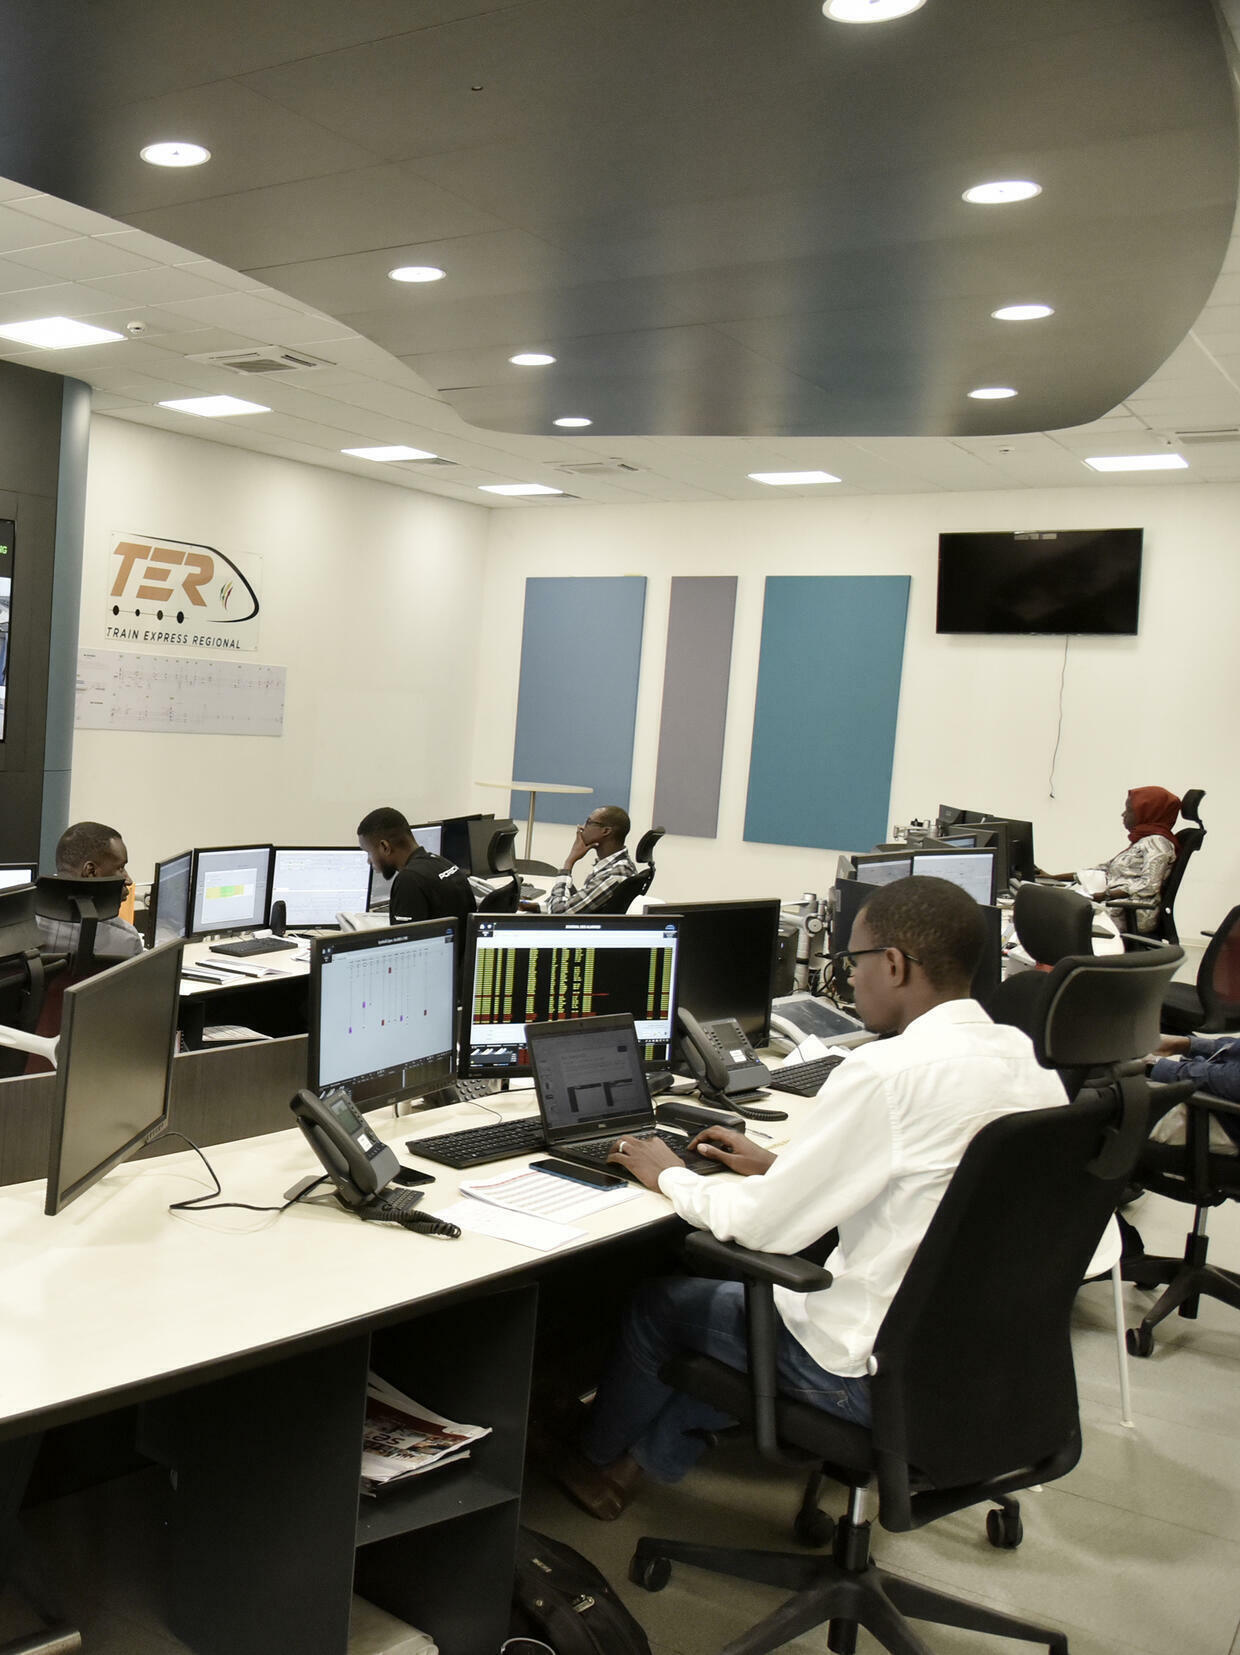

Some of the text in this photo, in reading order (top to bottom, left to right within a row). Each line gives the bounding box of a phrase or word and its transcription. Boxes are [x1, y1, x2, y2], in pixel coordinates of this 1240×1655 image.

[110, 541, 215, 607] TER
[106, 626, 241, 649] TRAIN EXPRESS REGIONAL
